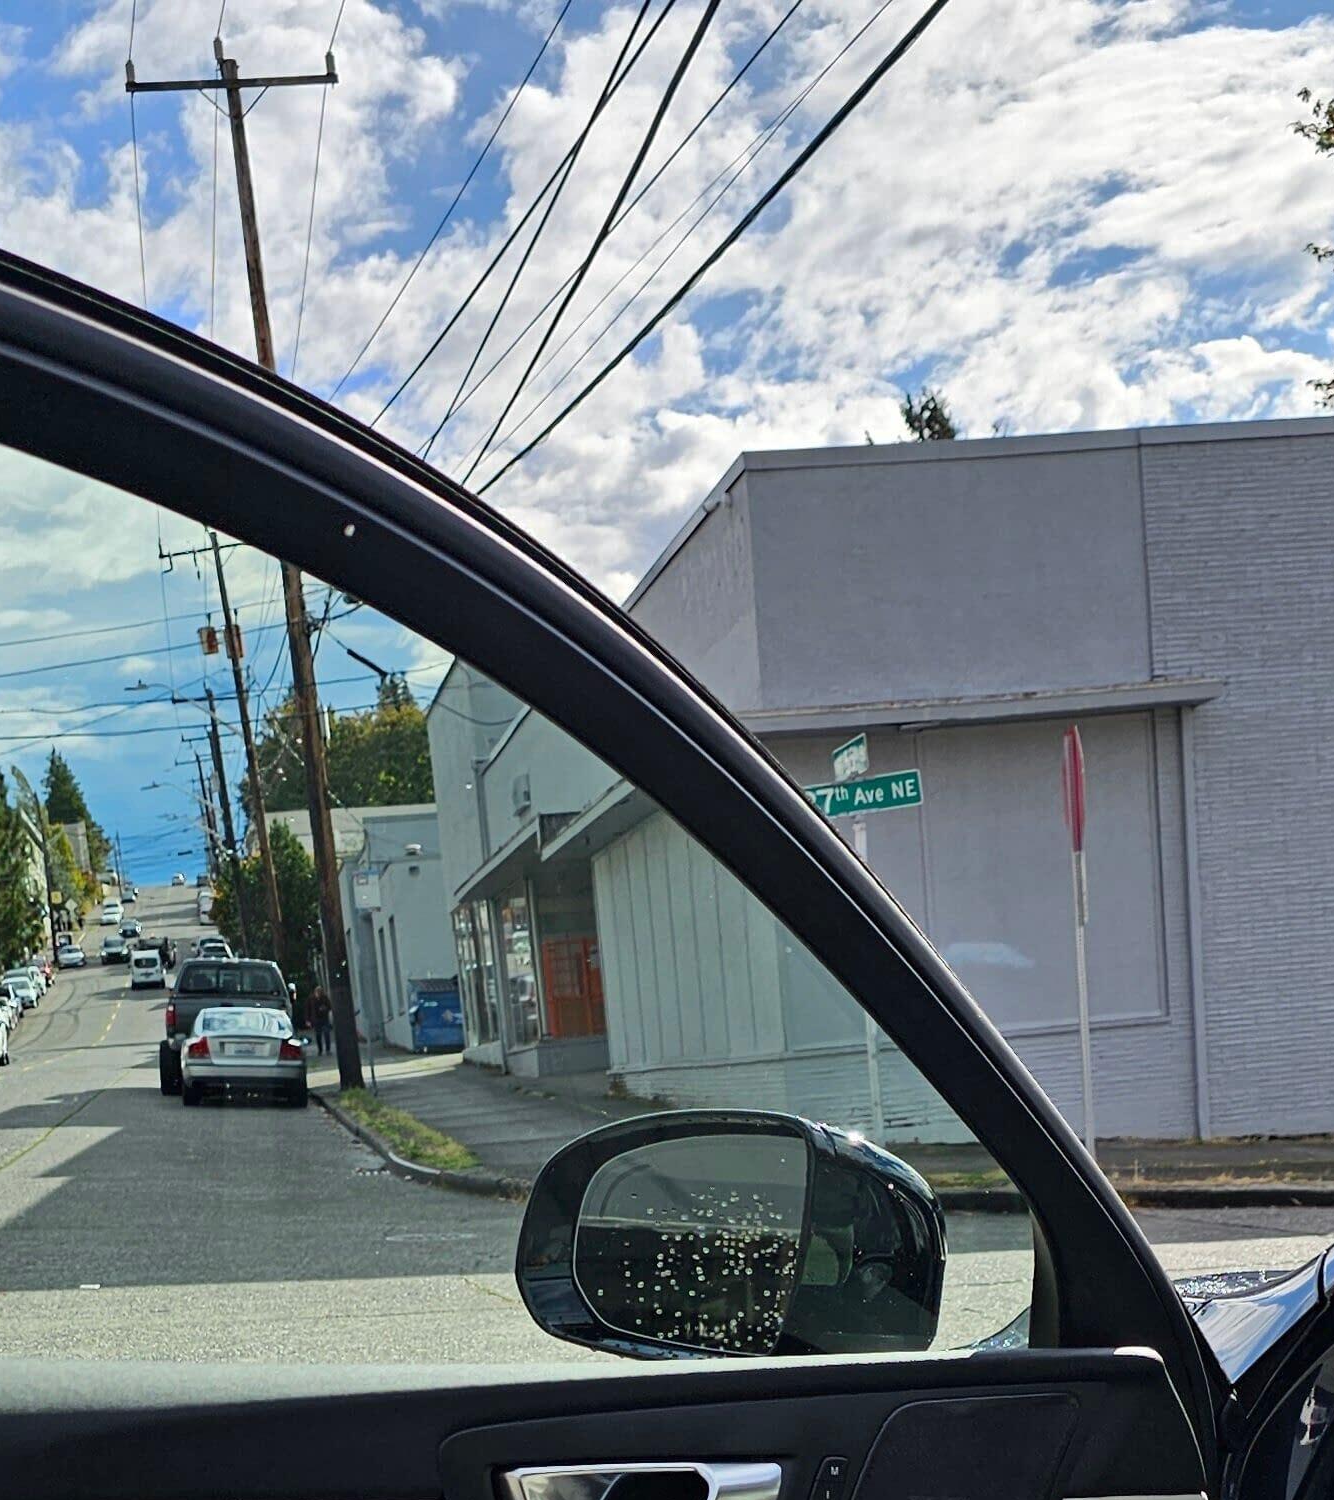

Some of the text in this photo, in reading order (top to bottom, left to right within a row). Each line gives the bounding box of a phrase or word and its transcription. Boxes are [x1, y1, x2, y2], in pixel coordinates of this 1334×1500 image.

[854, 787, 884, 806] Ave
[891, 779, 917, 799] NE
[830, 1466, 839, 1476] M
